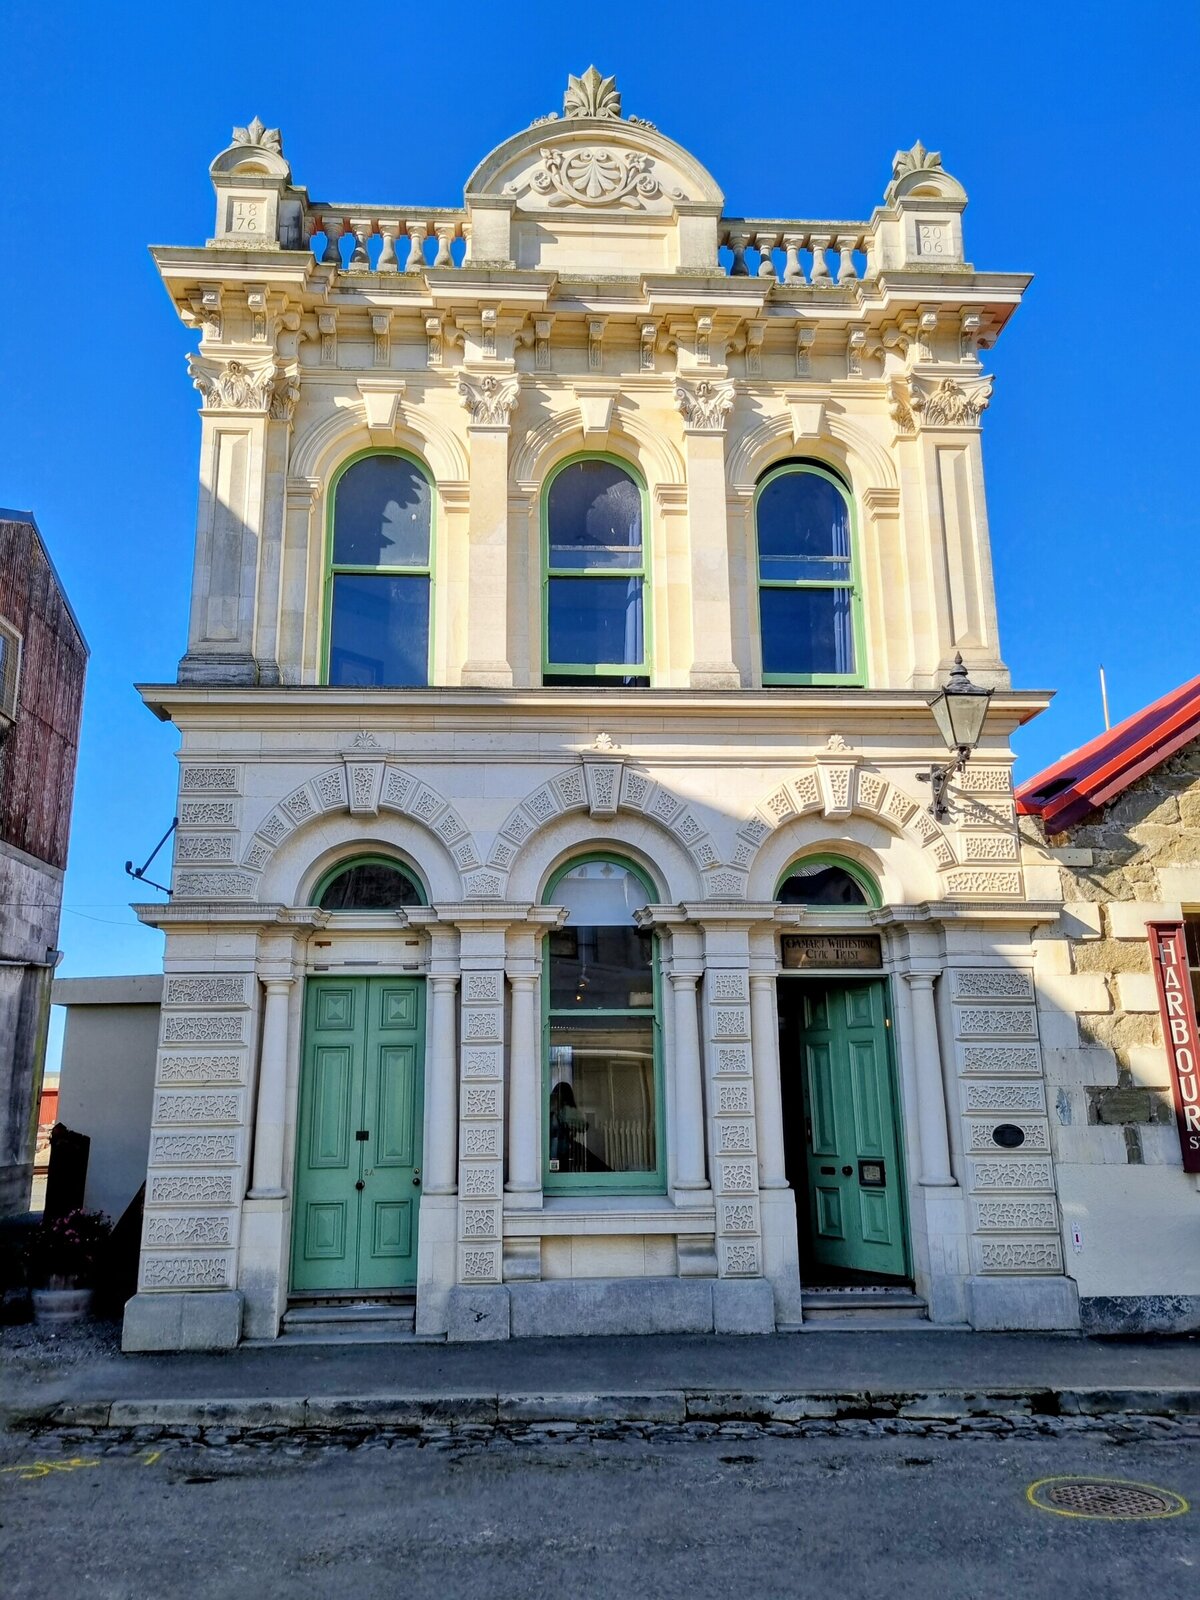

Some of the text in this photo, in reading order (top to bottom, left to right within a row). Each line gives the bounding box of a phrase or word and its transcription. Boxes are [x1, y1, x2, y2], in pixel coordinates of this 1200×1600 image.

[237, 203, 257, 216] 18
[236, 217, 257, 231] 76
[921, 226, 942, 239] 20
[923, 240, 943, 253] 06
[1158, 940, 1200, 1132] HARBOUR
